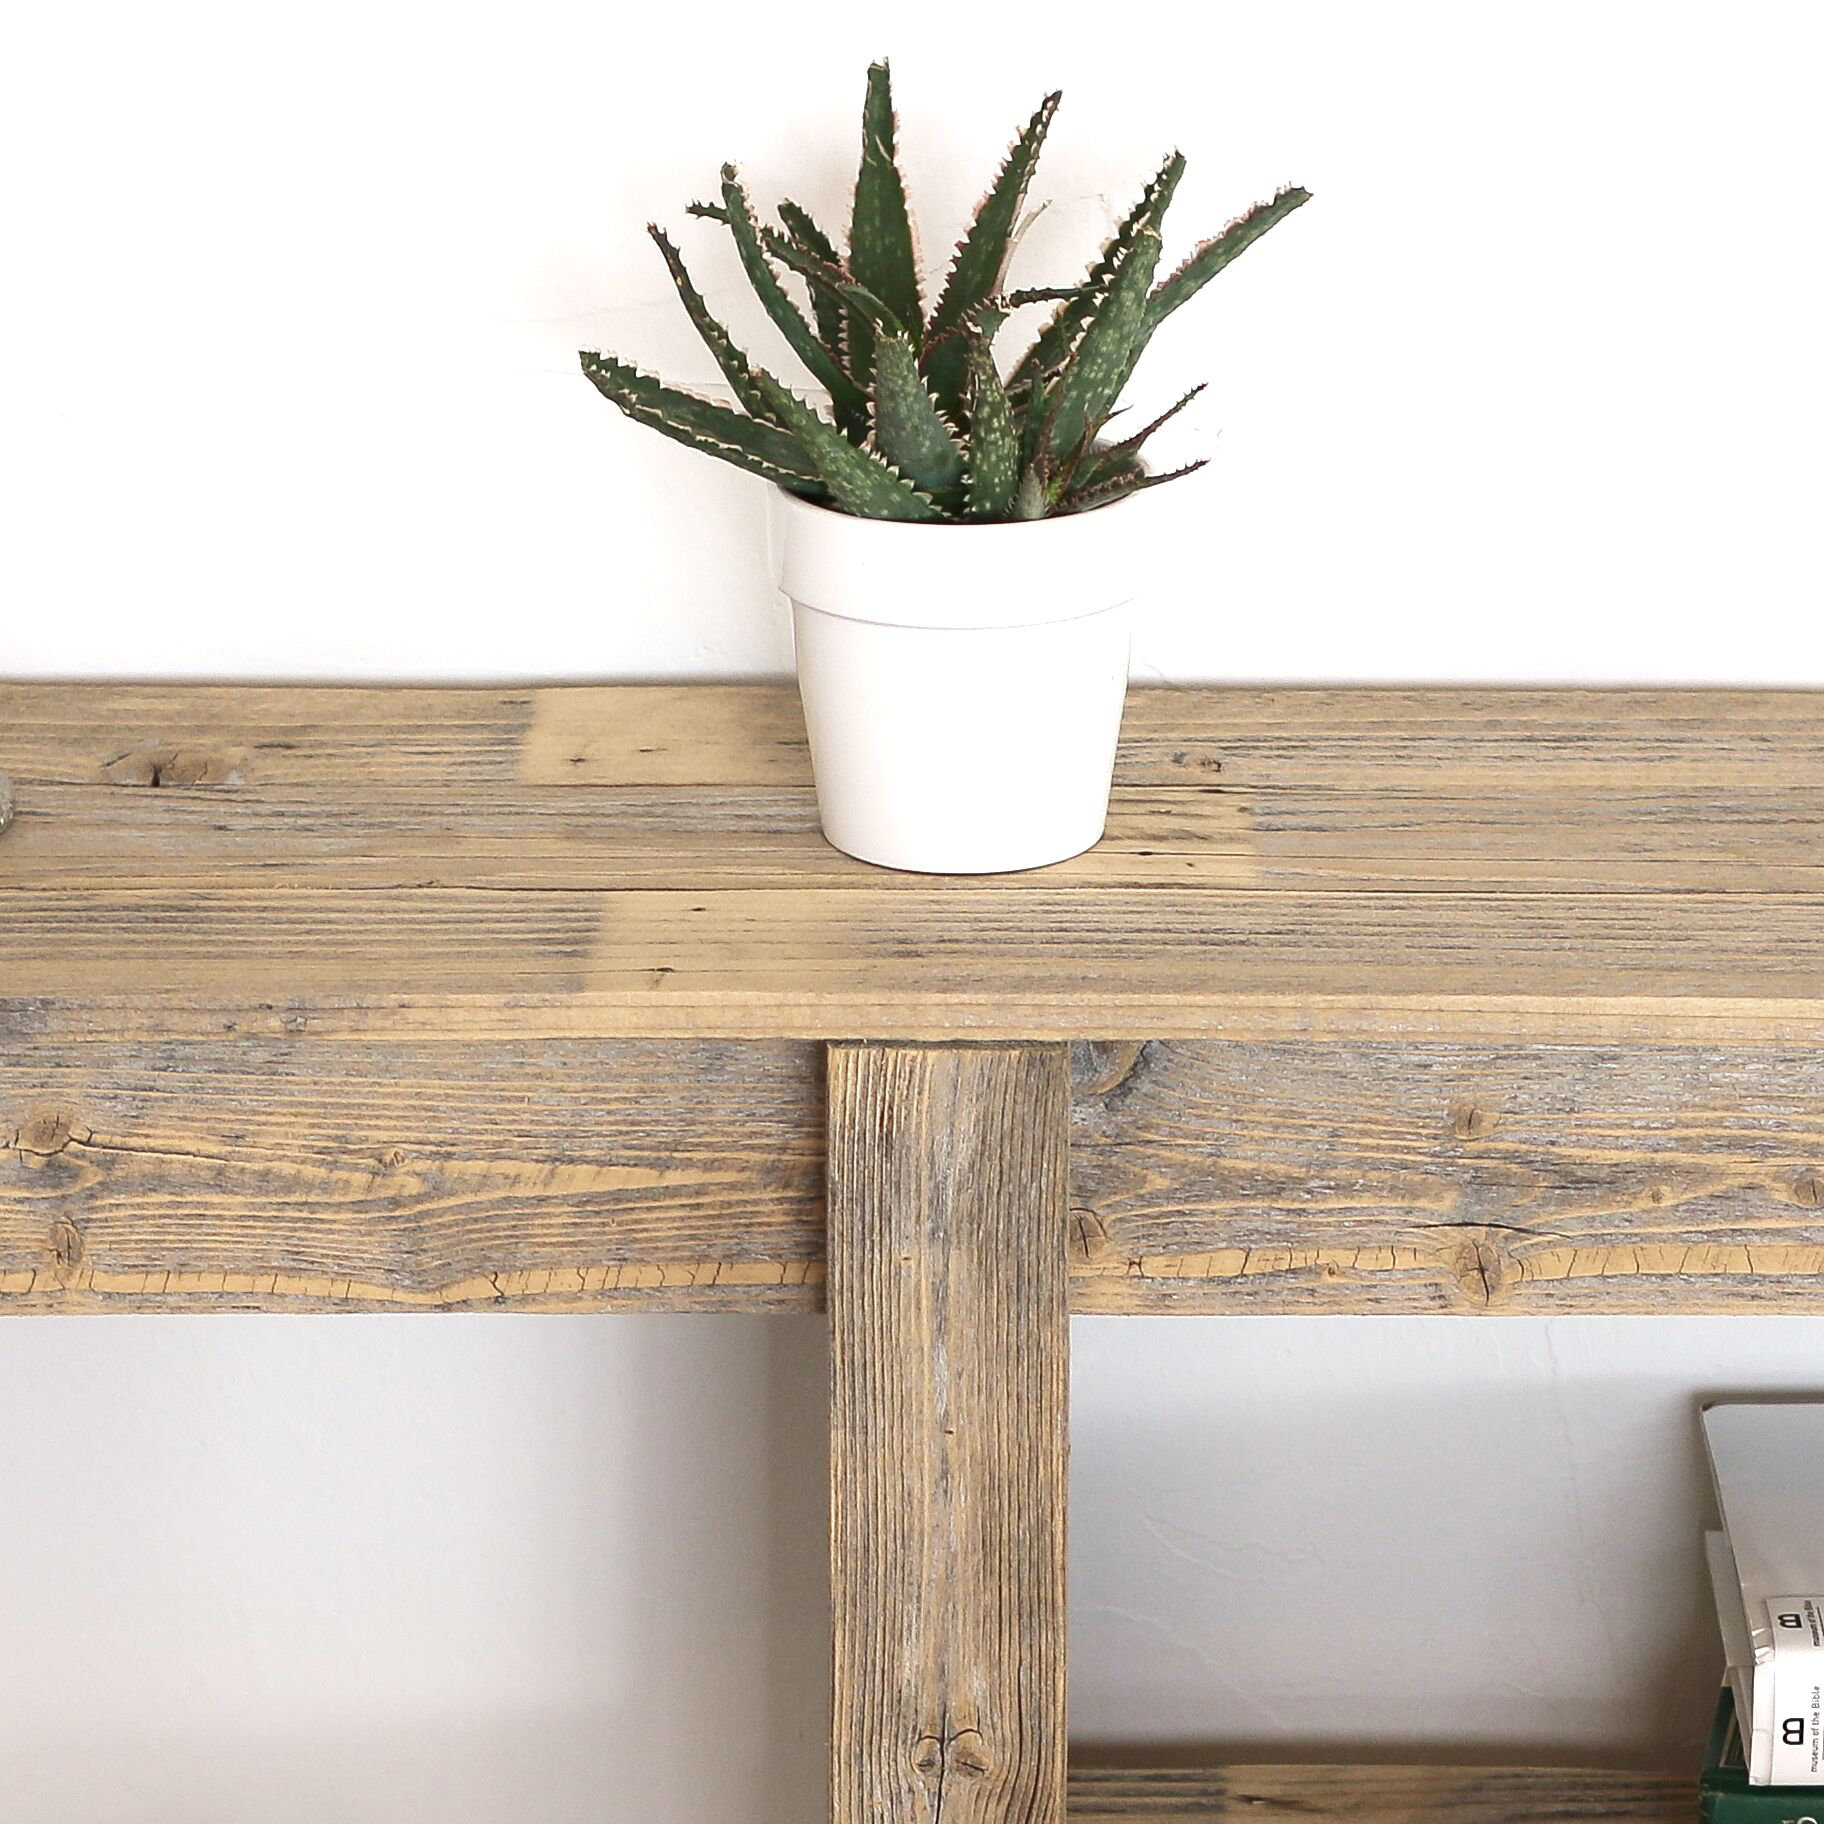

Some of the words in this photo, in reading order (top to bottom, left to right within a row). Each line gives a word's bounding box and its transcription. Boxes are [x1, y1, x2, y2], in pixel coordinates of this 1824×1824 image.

[1811, 1685, 1821, 1709] Bible
[1811, 1711, 1820, 1726] the
[1810, 1727, 1820, 1736] of
[1810, 1737, 1819, 1773] museum
